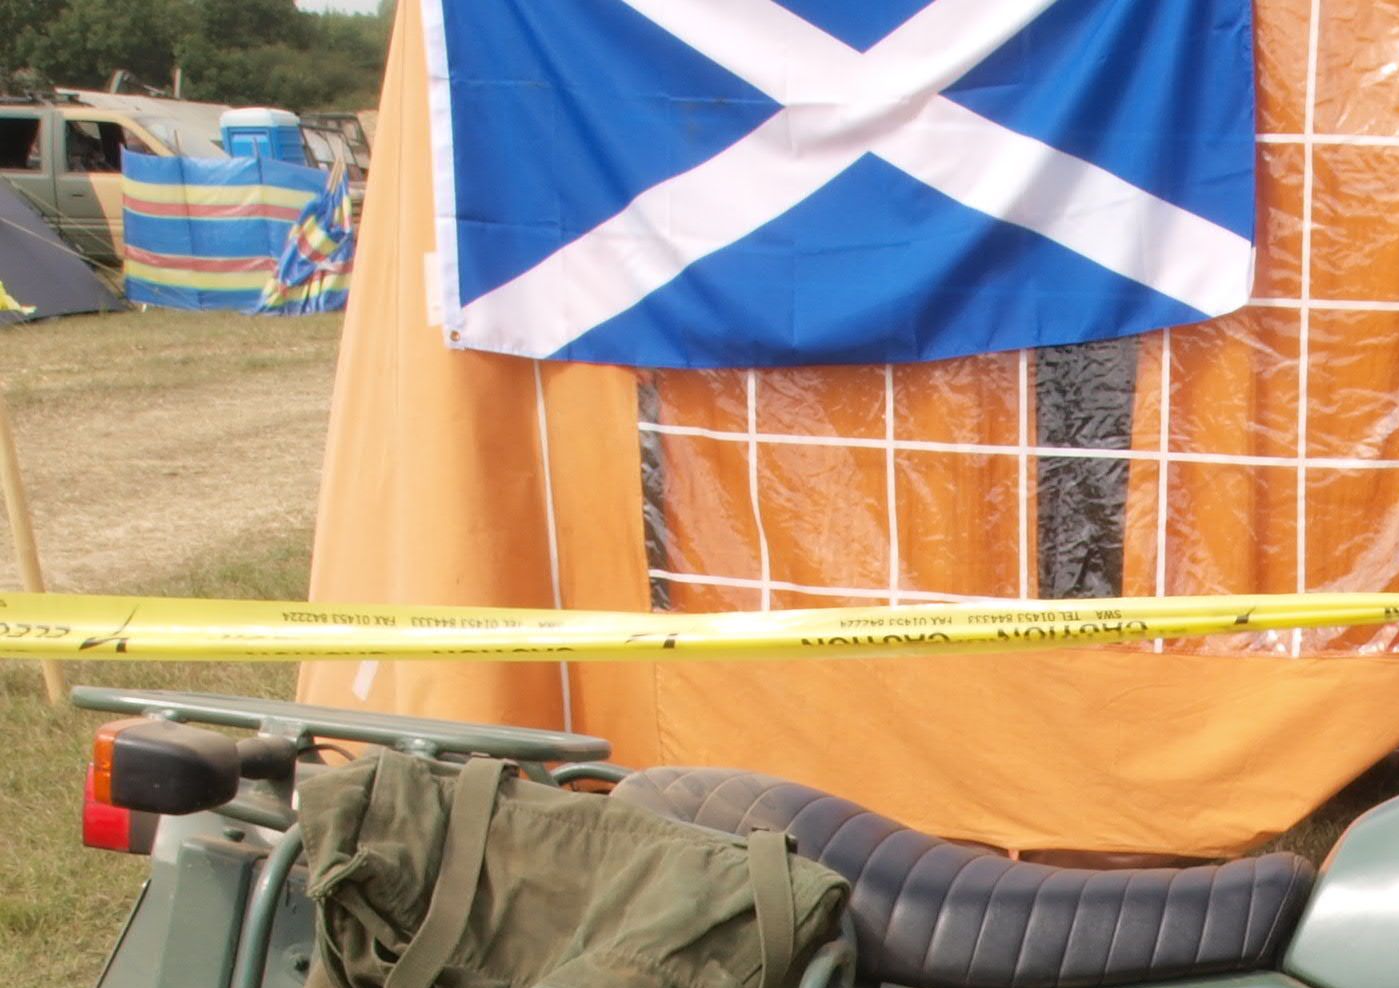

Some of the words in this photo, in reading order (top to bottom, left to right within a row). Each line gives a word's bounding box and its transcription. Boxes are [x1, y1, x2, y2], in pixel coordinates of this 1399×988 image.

[374, 615, 397, 626] FAX
[1061, 611, 1081, 622] TEL
[1095, 610, 1122, 620] SWA
